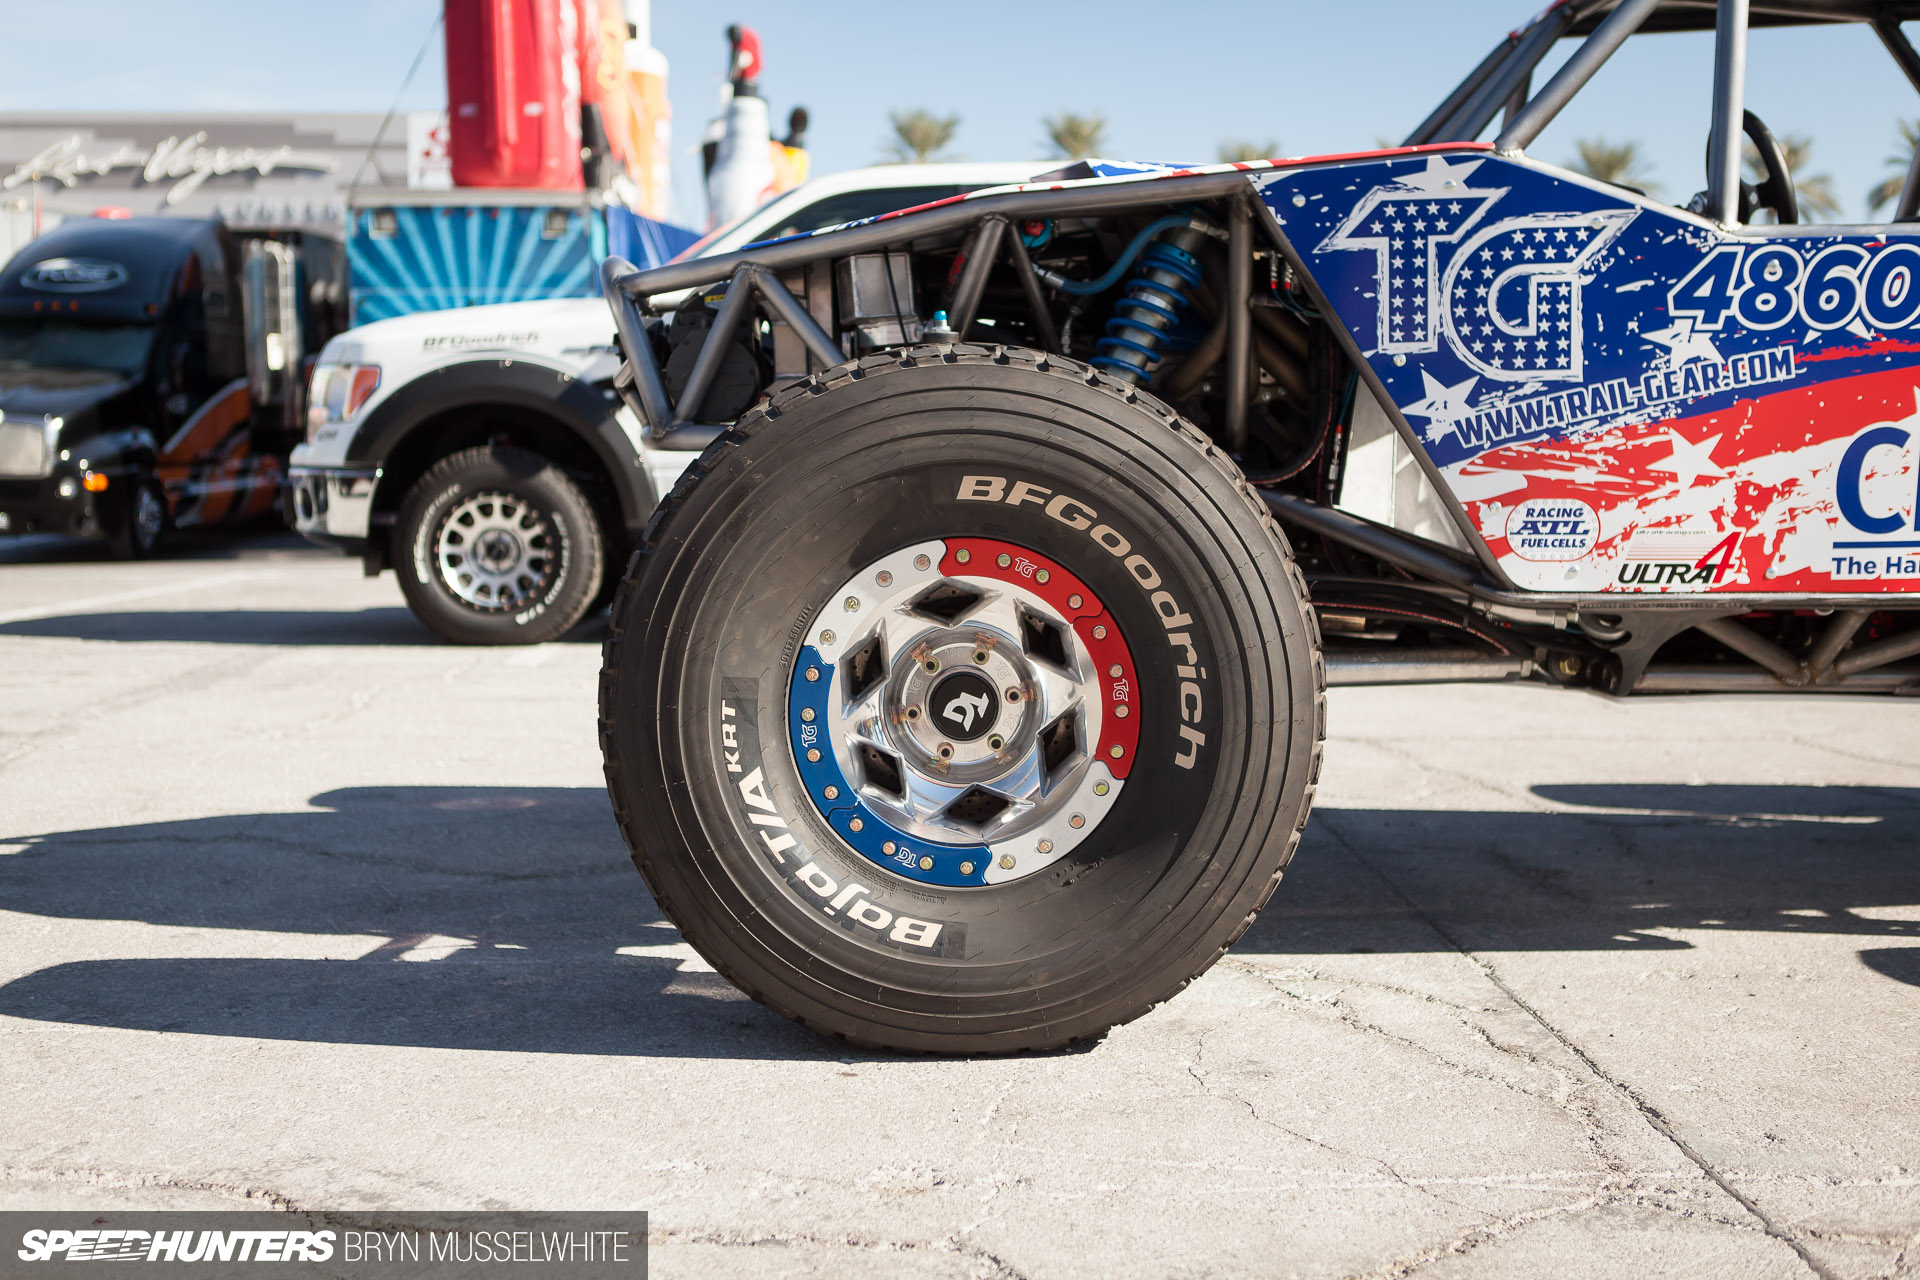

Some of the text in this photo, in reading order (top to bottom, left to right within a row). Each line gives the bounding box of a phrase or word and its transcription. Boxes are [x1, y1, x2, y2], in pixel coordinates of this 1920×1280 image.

[1312, 186, 1643, 382] TG
[1667, 243, 1920, 331] 4860
[1453, 345, 1796, 448] WWW.TRAIL-GEAR.COM
[1525, 507, 1584, 518] RACING
[1836, 426, 1920, 534] C
[1510, 520, 1590, 536] ATL
[1015, 557, 1037, 578] TG
[1832, 556, 1920, 575] The Ha
[956, 475, 1207, 770] BFGoodrich
[1113, 679, 1129, 702] TG
[721, 700, 743, 773] KRT
[801, 724, 817, 748] TG
[738, 766, 797, 864] T/A
[894, 847, 917, 869] TG
[794, 861, 943, 948] Baja
